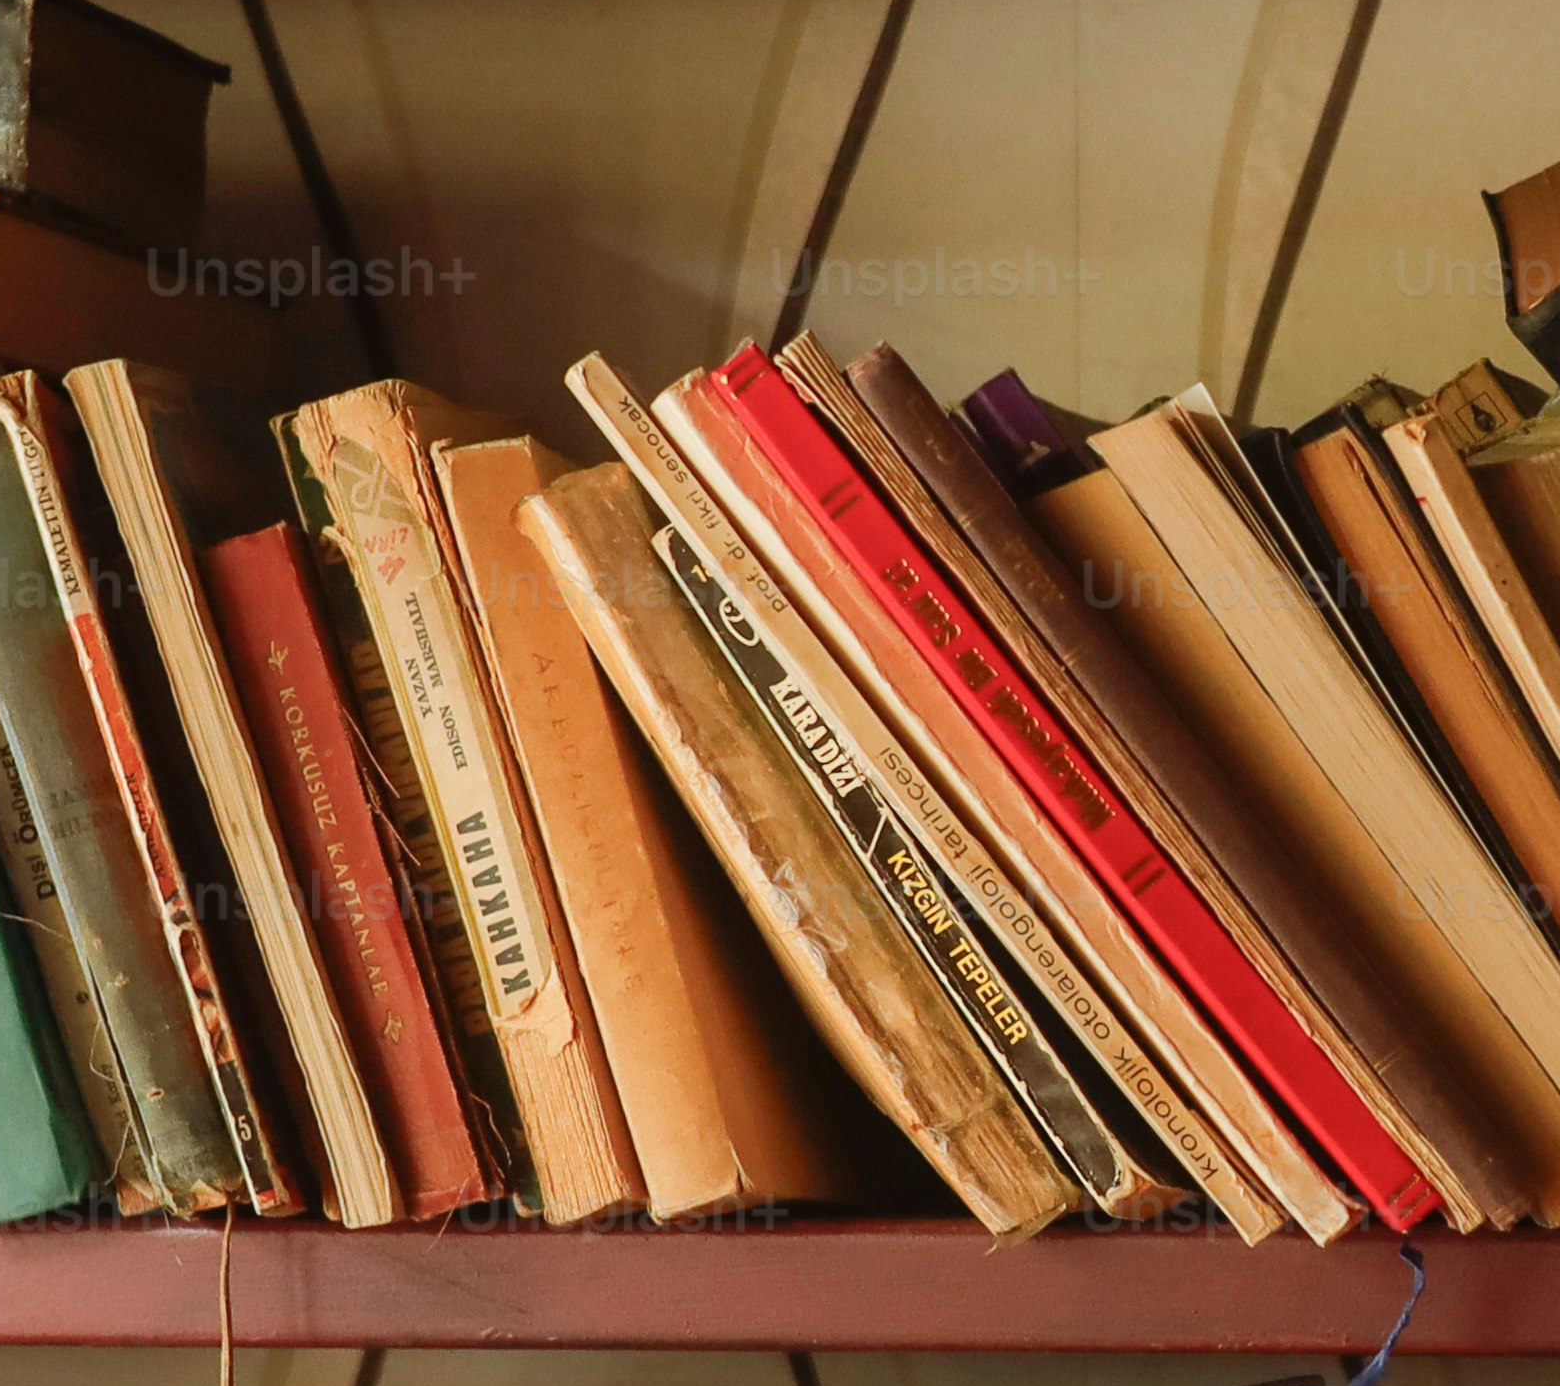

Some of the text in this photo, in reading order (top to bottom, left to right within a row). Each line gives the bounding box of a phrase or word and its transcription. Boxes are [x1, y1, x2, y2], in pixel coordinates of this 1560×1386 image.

[278, 685, 388, 1001] KORKUSUZ KAPTANLAR
[879, 745, 964, 858] tarihçesi
[458, 809, 529, 997] KAHKAHA
[886, 847, 1028, 1045] KIZGIN TEPELER
[964, 847, 1114, 1044] otolarengoloji
[1113, 1045, 1218, 1181] kronolojik
